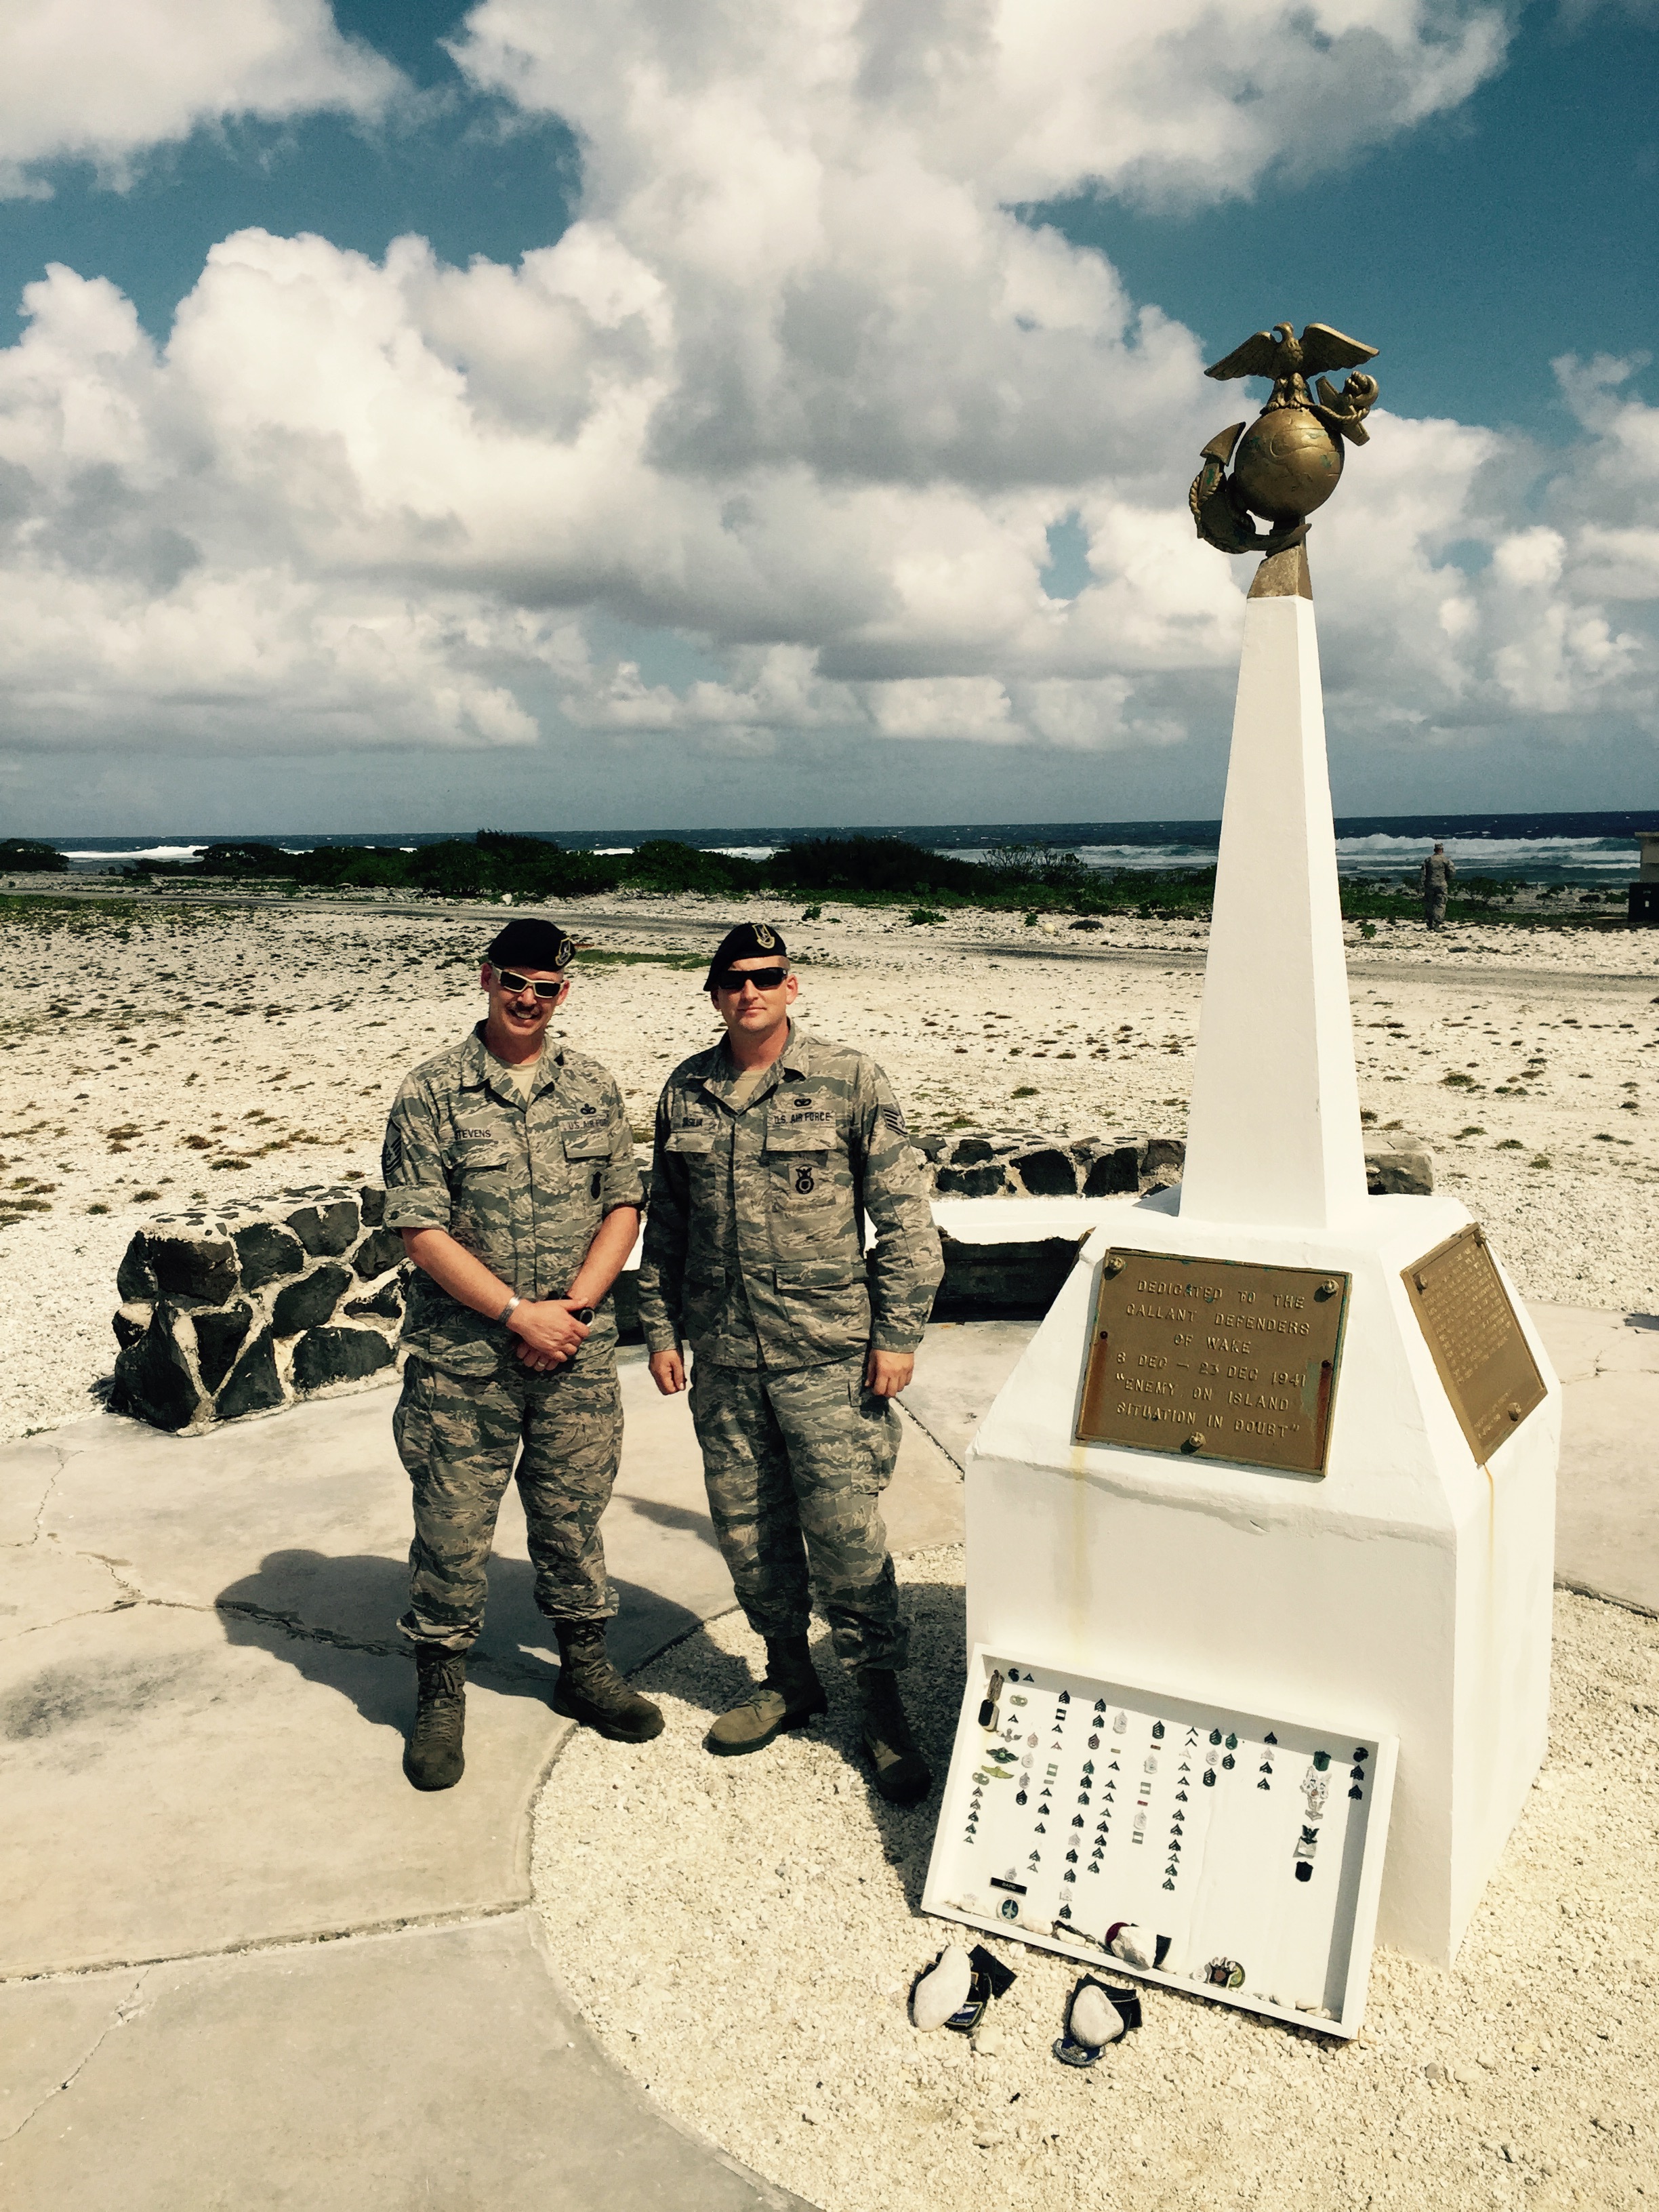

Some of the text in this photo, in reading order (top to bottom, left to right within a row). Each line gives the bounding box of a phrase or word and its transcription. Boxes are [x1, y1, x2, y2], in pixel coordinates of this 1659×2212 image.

[790, 1113, 803, 1124] AIR
[804, 1111, 832, 1122] FORCE
[1138, 1279, 1305, 1309] DEDICATED TO THE
[1126, 1303, 1310, 1336] GALLANT DEFENDERS
[1174, 1333, 1252, 1354] OF WAKE
[1117, 1351, 1126, 1364] 8
[1139, 1354, 1168, 1368] DEC
[1200, 1361, 1219, 1375] 23
[1227, 1365, 1258, 1381] DEC
[1271, 1371, 1306, 1387] 1941
[1193, 1386, 1212, 1401] ON
[1227, 1390, 1289, 1411] ISLAND
[1116, 1401, 1196, 1425] SITUATION
[1206, 1414, 1224, 1429] IN
